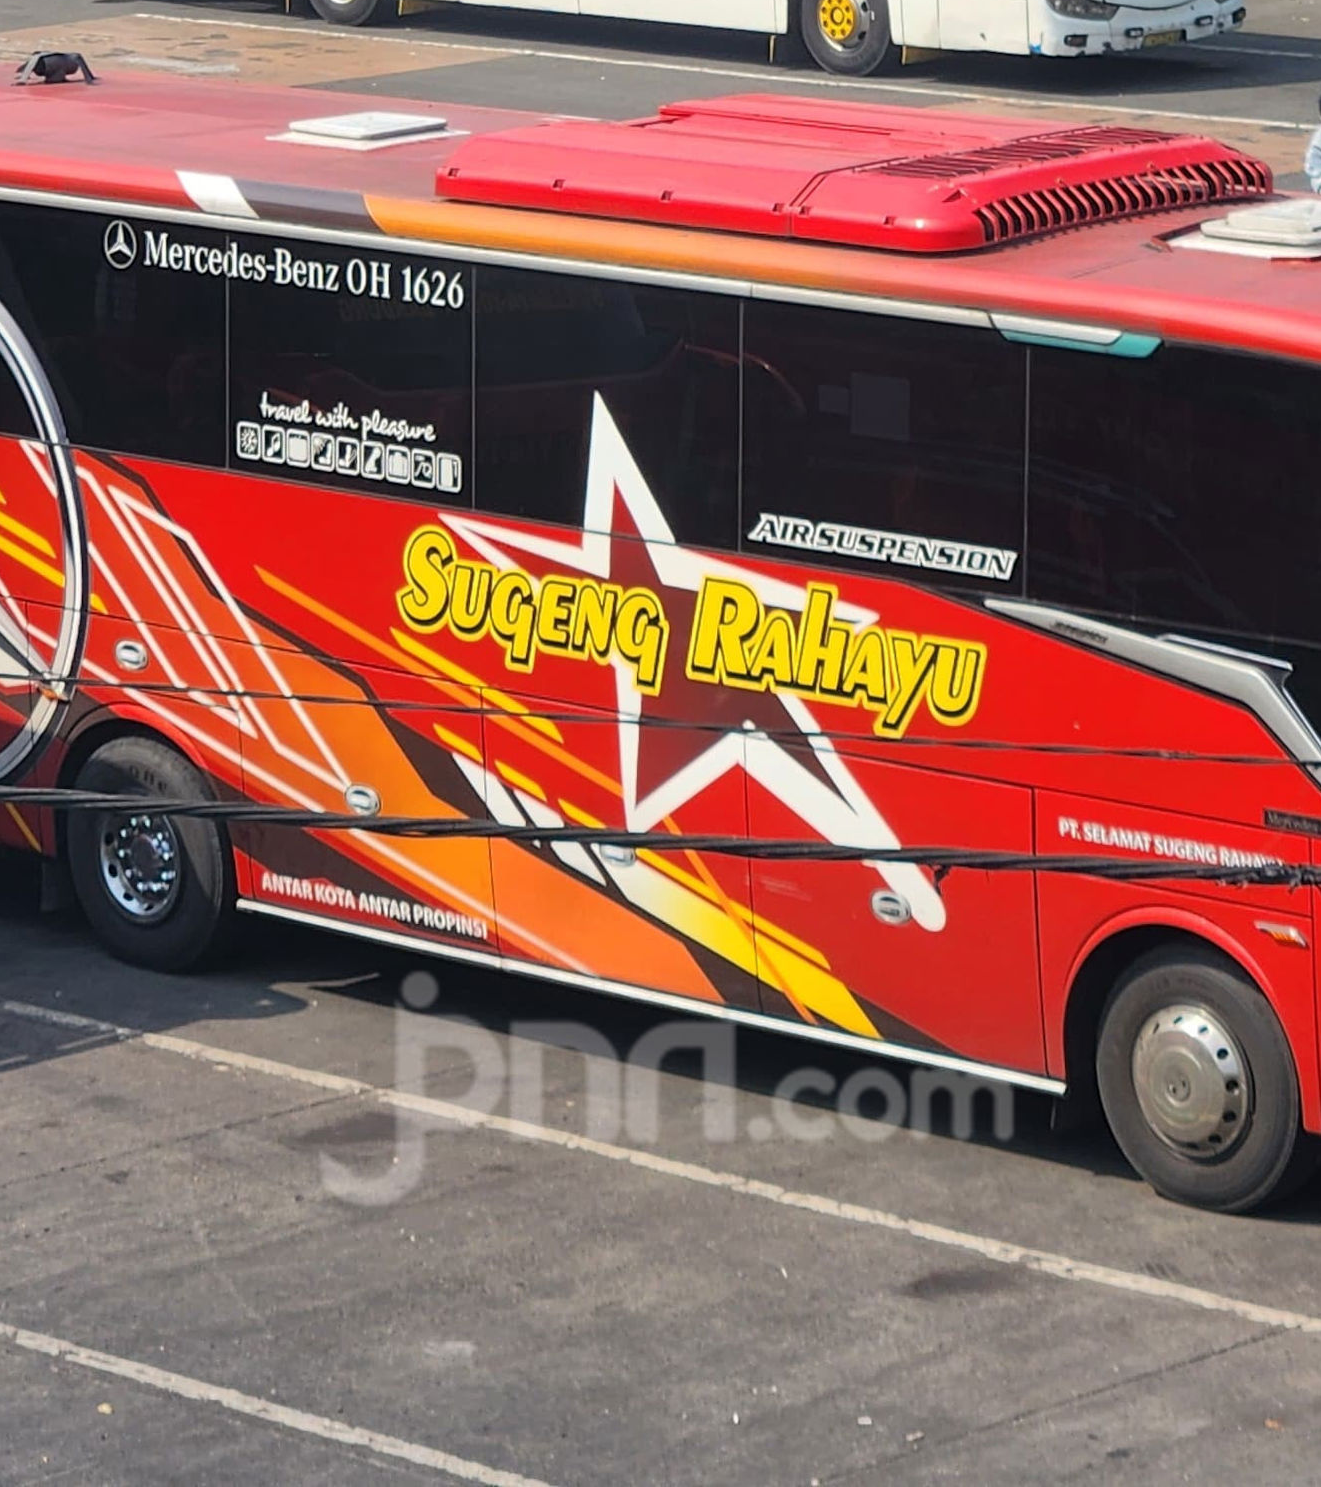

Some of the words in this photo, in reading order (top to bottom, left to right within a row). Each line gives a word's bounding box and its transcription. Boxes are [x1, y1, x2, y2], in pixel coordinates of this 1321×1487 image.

[144, 230, 340, 292] Mercedes-Benz
[345, 265, 391, 300] OH
[401, 270, 465, 310] 1626
[259, 391, 313, 424] travel
[314, 399, 358, 435] with
[360, 411, 436, 444] pleasure
[747, 513, 814, 547] AIR
[814, 521, 1017, 581] SUSPENSION
[397, 524, 669, 695] SUGENG
[1058, 817, 1082, 841] PT.
[1083, 823, 1151, 854] SELAMAT
[1153, 835, 1219, 866] SUGENG
[261, 871, 312, 902] ANTAR
[313, 879, 357, 912] KOTA
[357, 890, 413, 921] ANTAR
[413, 901, 489, 940] PROPINSI
